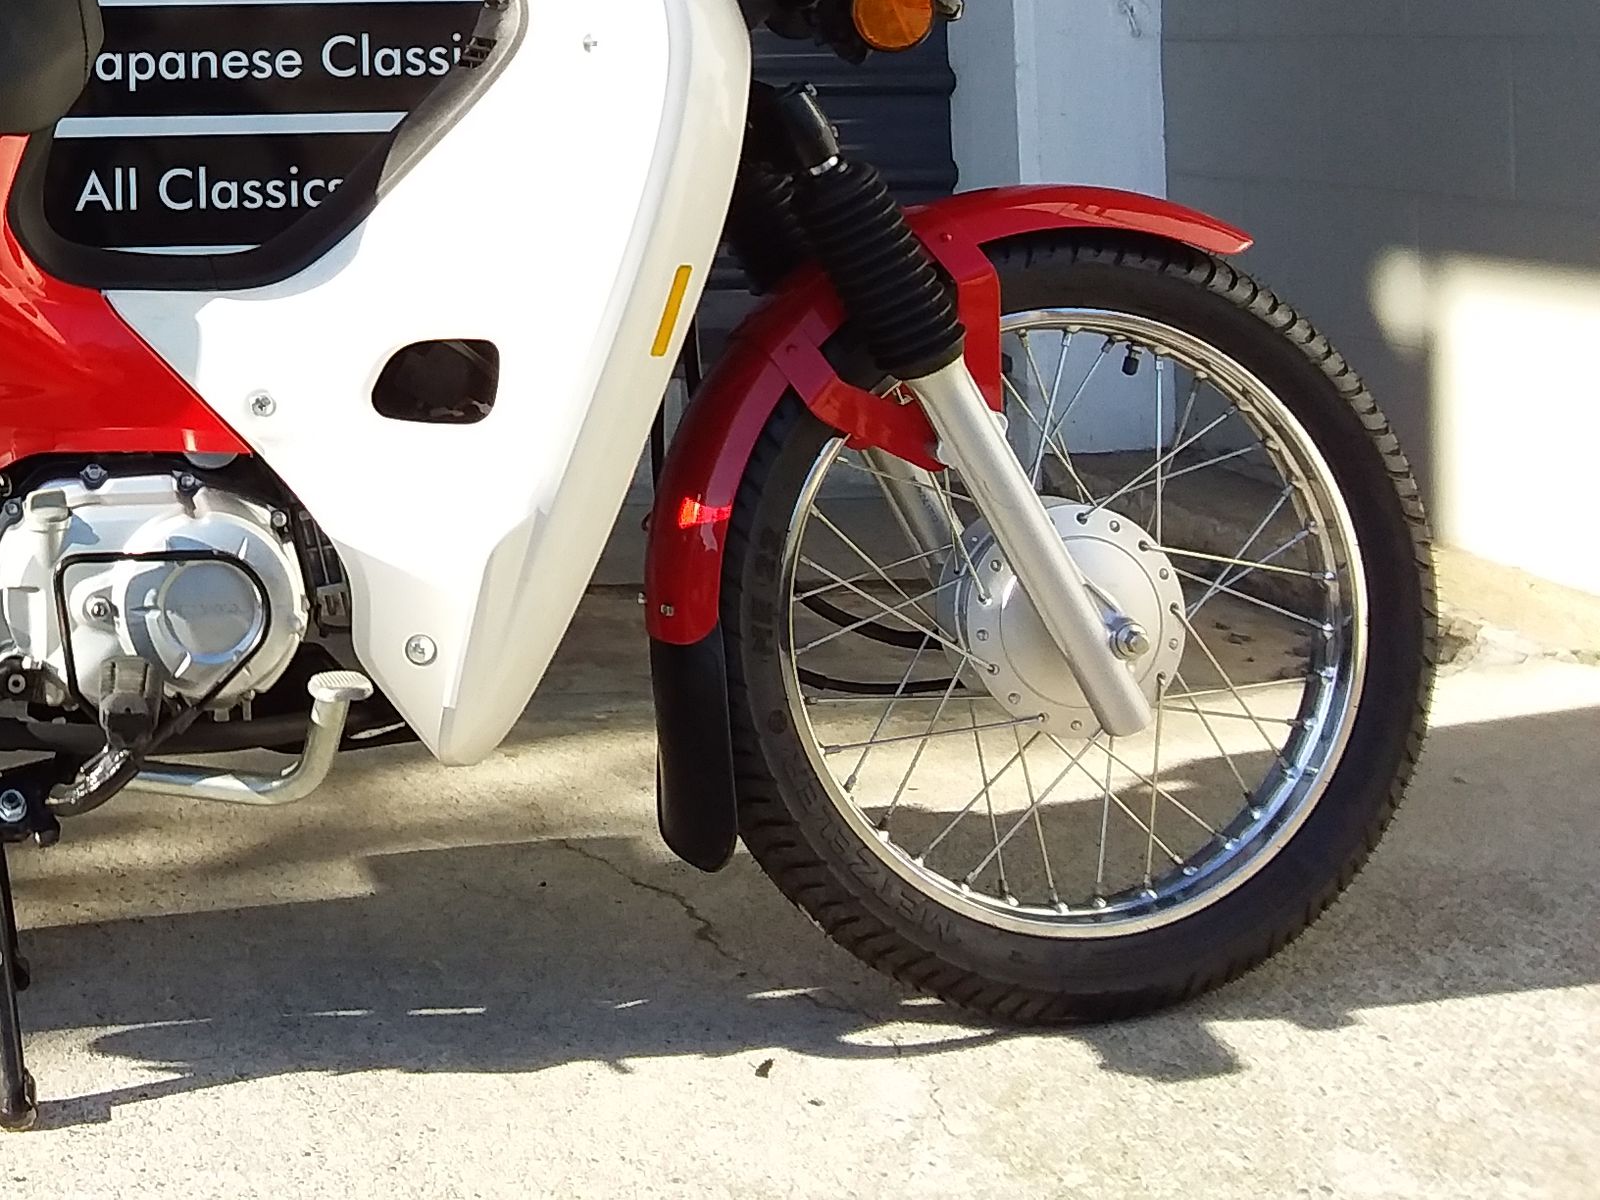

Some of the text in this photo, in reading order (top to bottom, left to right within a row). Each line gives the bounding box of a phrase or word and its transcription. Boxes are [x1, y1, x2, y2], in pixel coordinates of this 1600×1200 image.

[97, 32, 462, 92] apanese Classi
[75, 167, 137, 212] All
